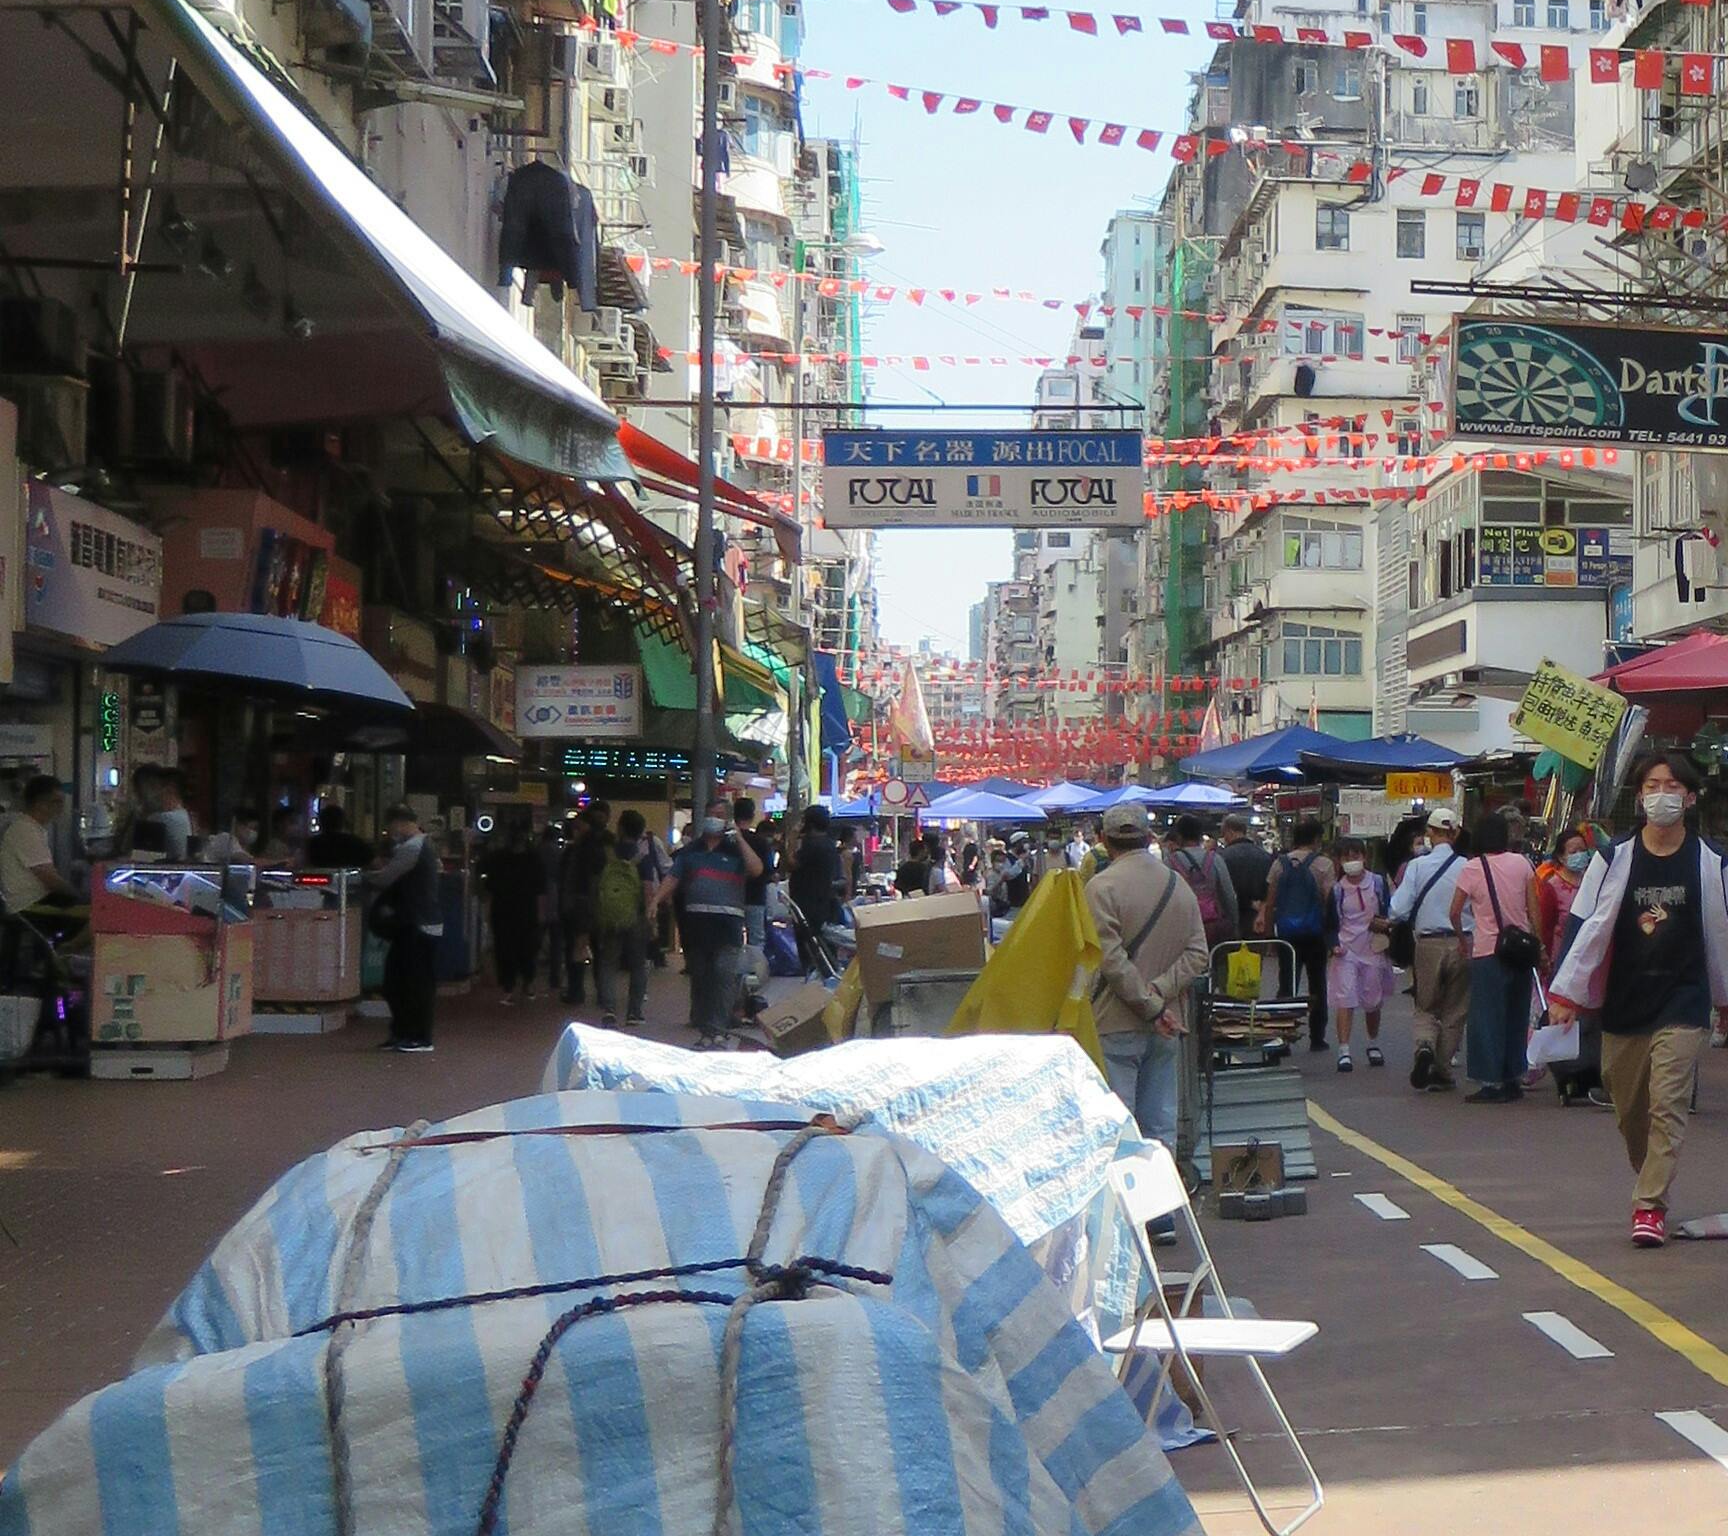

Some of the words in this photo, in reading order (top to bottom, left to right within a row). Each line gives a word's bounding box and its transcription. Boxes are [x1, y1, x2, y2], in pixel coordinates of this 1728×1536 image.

[1460, 422, 1621, 440] www.dartspoint.com
[1628, 430, 1662, 443] TEL:
[1666, 432, 1703, 445] 5441
[843, 440, 975, 463] 天下名器
[1514, 529, 1540, 537] Plus
